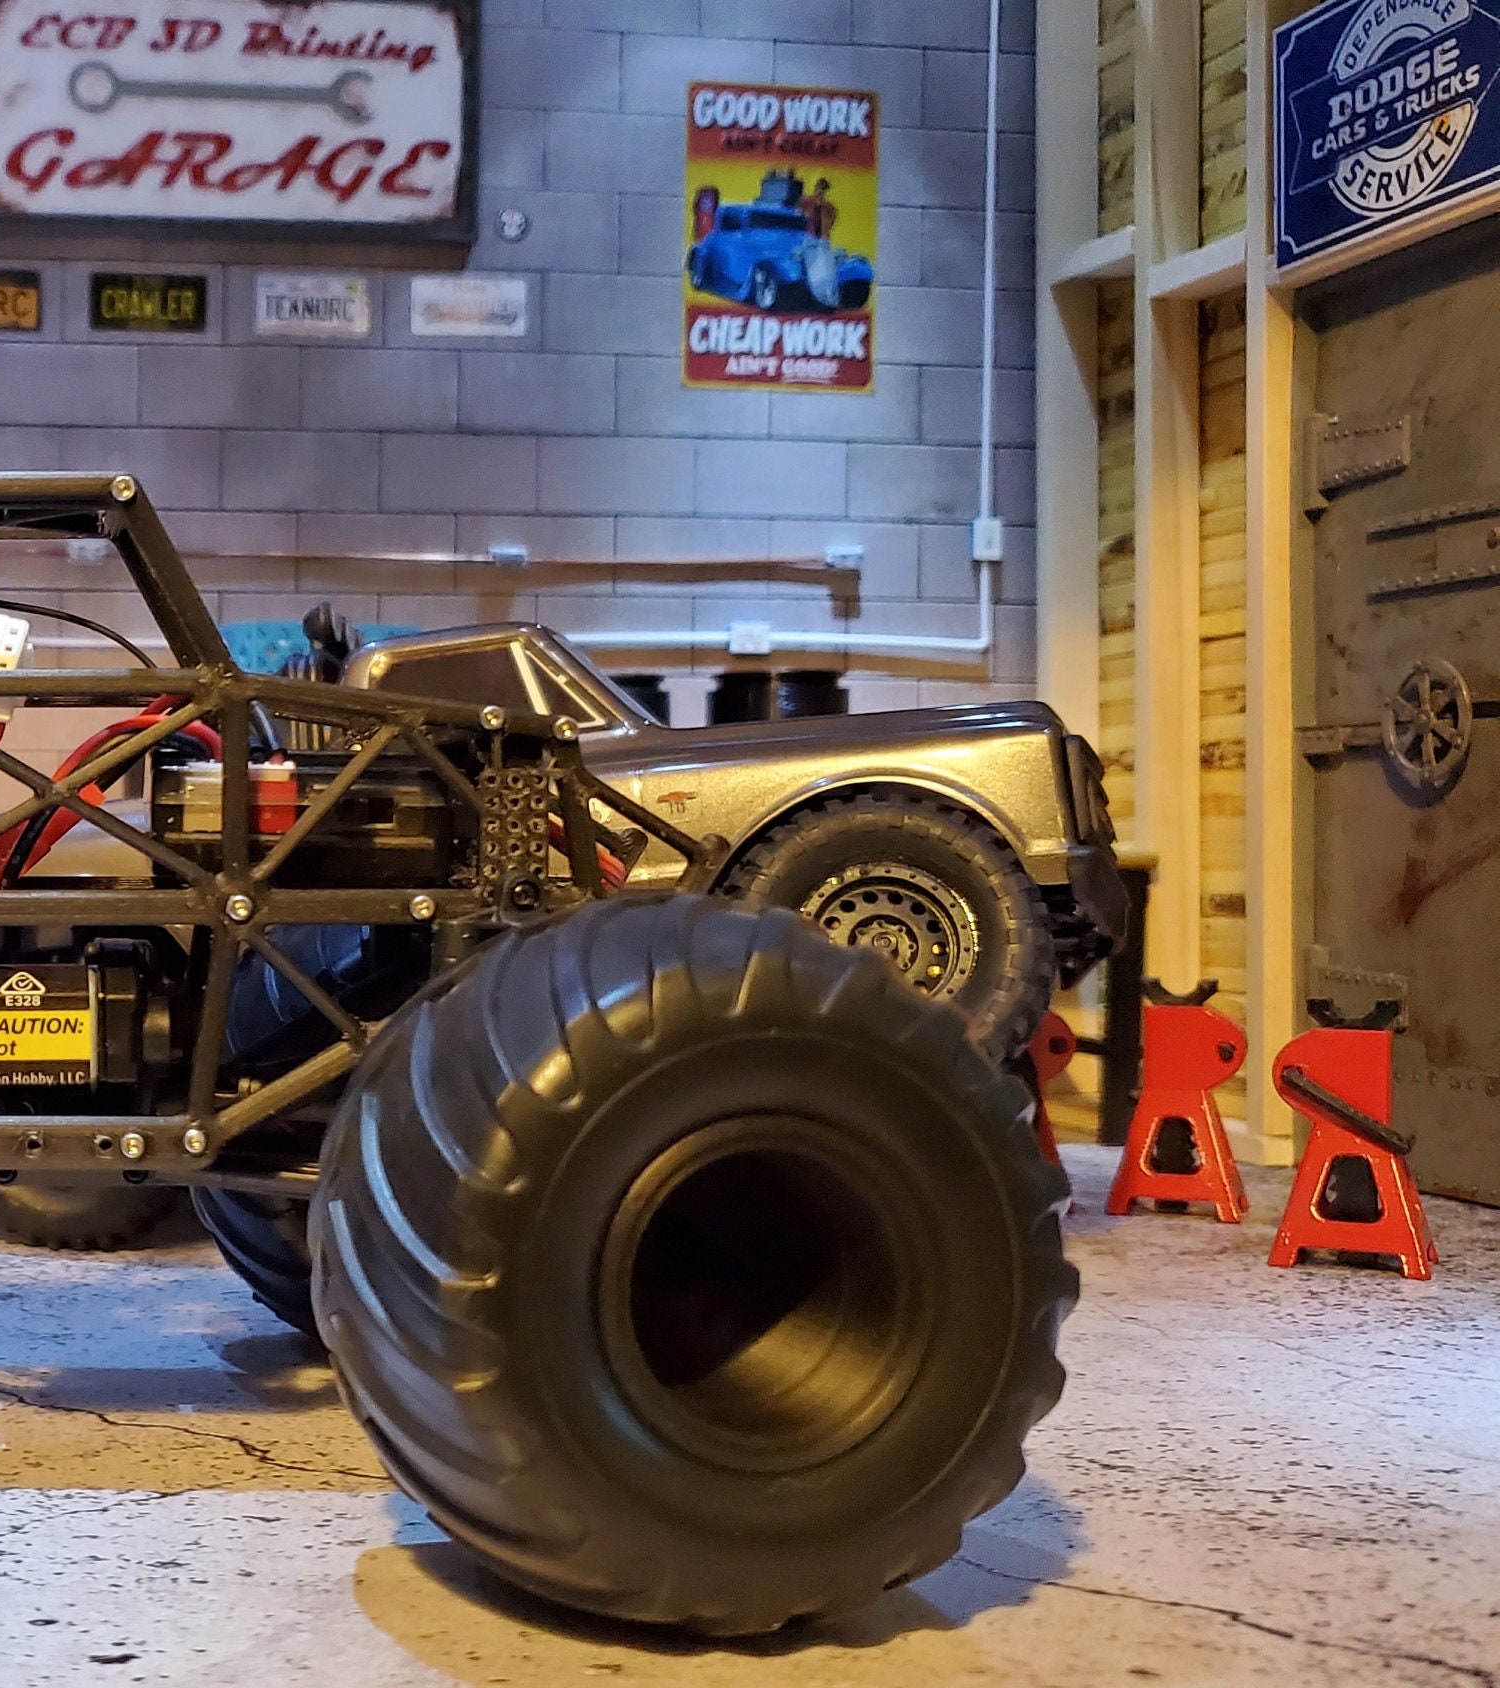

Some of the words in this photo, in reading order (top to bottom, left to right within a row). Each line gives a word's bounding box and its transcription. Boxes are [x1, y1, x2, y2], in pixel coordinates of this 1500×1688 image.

[20, 14, 136, 52] ECB
[148, 18, 223, 54] 3D
[240, 21, 437, 74] Printing
[1312, 117, 1366, 160] CARS
[1374, 109, 1390, 131] &
[1393, 64, 1481, 121] TRUCKS
[1328, 38, 1460, 129] DODGE
[693, 90, 780, 131] GOOD
[783, 94, 871, 139] WORK
[5, 127, 451, 202] GARAGE
[1343, 119, 1457, 204] SERVICE
[689, 314, 781, 355] CHEAP
[782, 317, 867, 361] WORK
[5, 995, 41, 1006] E328
[60, 1071, 85, 1085] LLC
